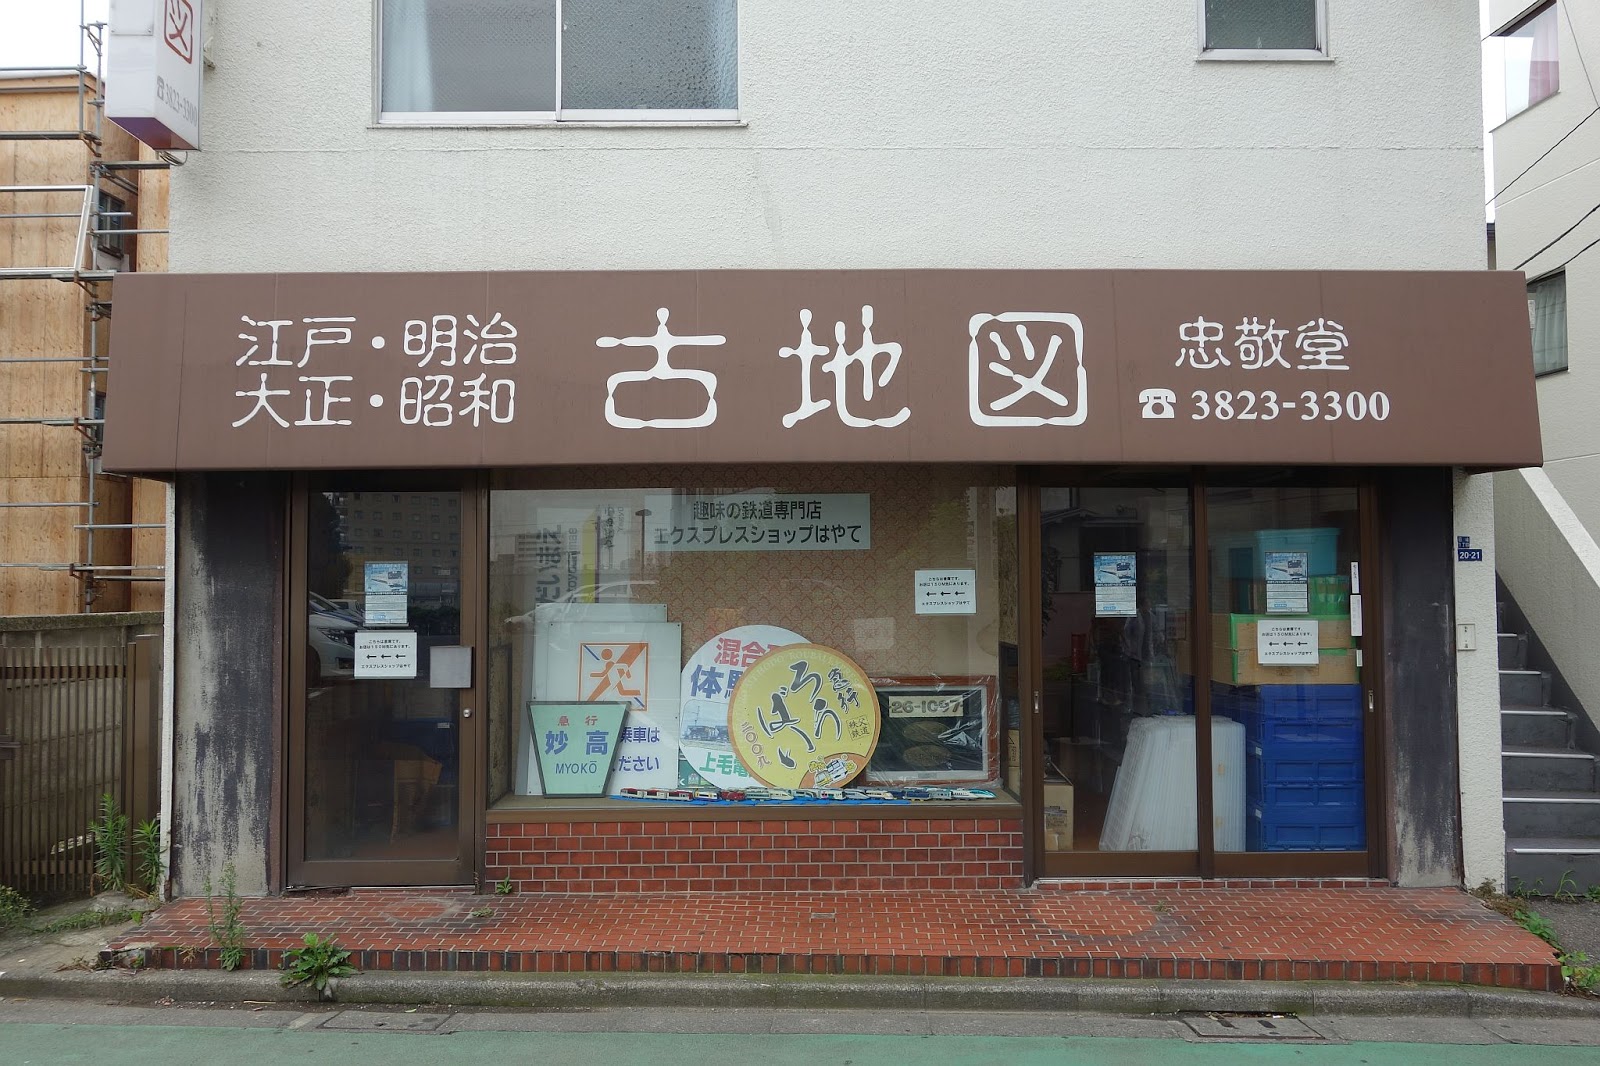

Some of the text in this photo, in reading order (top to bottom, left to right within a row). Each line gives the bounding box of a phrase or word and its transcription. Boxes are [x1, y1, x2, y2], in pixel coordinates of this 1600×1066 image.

[235, 312, 518, 368] 江戸・明治
[1175, 315, 1350, 371] 忠敬堂
[596, 304, 1089, 429] 古地図
[231, 372, 516, 428] 大正・昭和
[1191, 390, 1390, 421] 3823-3300
[693, 500, 822, 520] 趣味の鉄道専門店
[654, 524, 862, 545] エクスプレスショップはやて
[714, 637, 782, 668] 混合
[544, 730, 609, 755] 妙高
